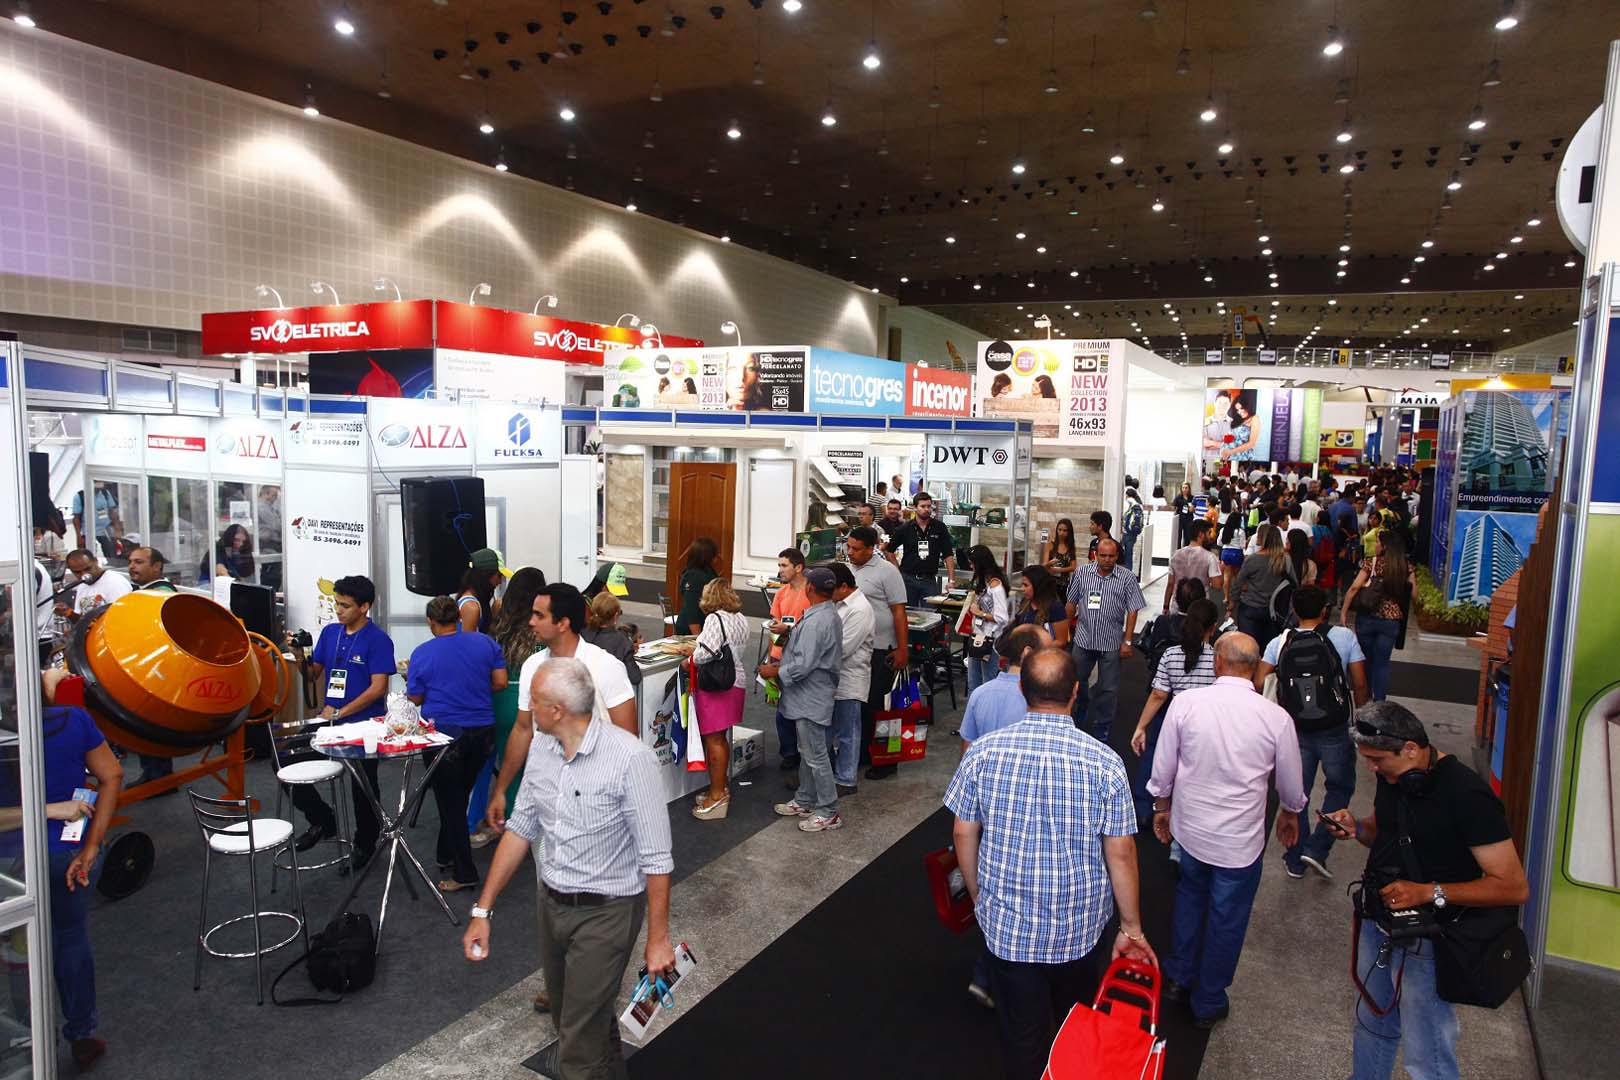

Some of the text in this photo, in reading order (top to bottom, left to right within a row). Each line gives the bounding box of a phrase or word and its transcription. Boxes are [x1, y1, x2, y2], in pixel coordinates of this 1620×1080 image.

[1074, 358, 1097, 370] HD
[703, 377, 724, 387] NEW
[813, 364, 903, 407] tecnogres
[1071, 375, 1108, 389] NEW
[912, 368, 968, 411] incenor
[702, 393, 724, 403] 2013
[1070, 397, 1107, 411] 2013
[1069, 418, 1106, 429] 46x93
[1273, 389, 1290, 461] BERINJELA
[410, 425, 468, 448] ALZA
[236, 435, 279, 459] ALZA
[494, 449, 543, 457] FUCKSA
[933, 446, 989, 465] DWT
[1458, 493, 1532, 505] Empreendimentos
[323, 537, 361, 546] 3496.4491
